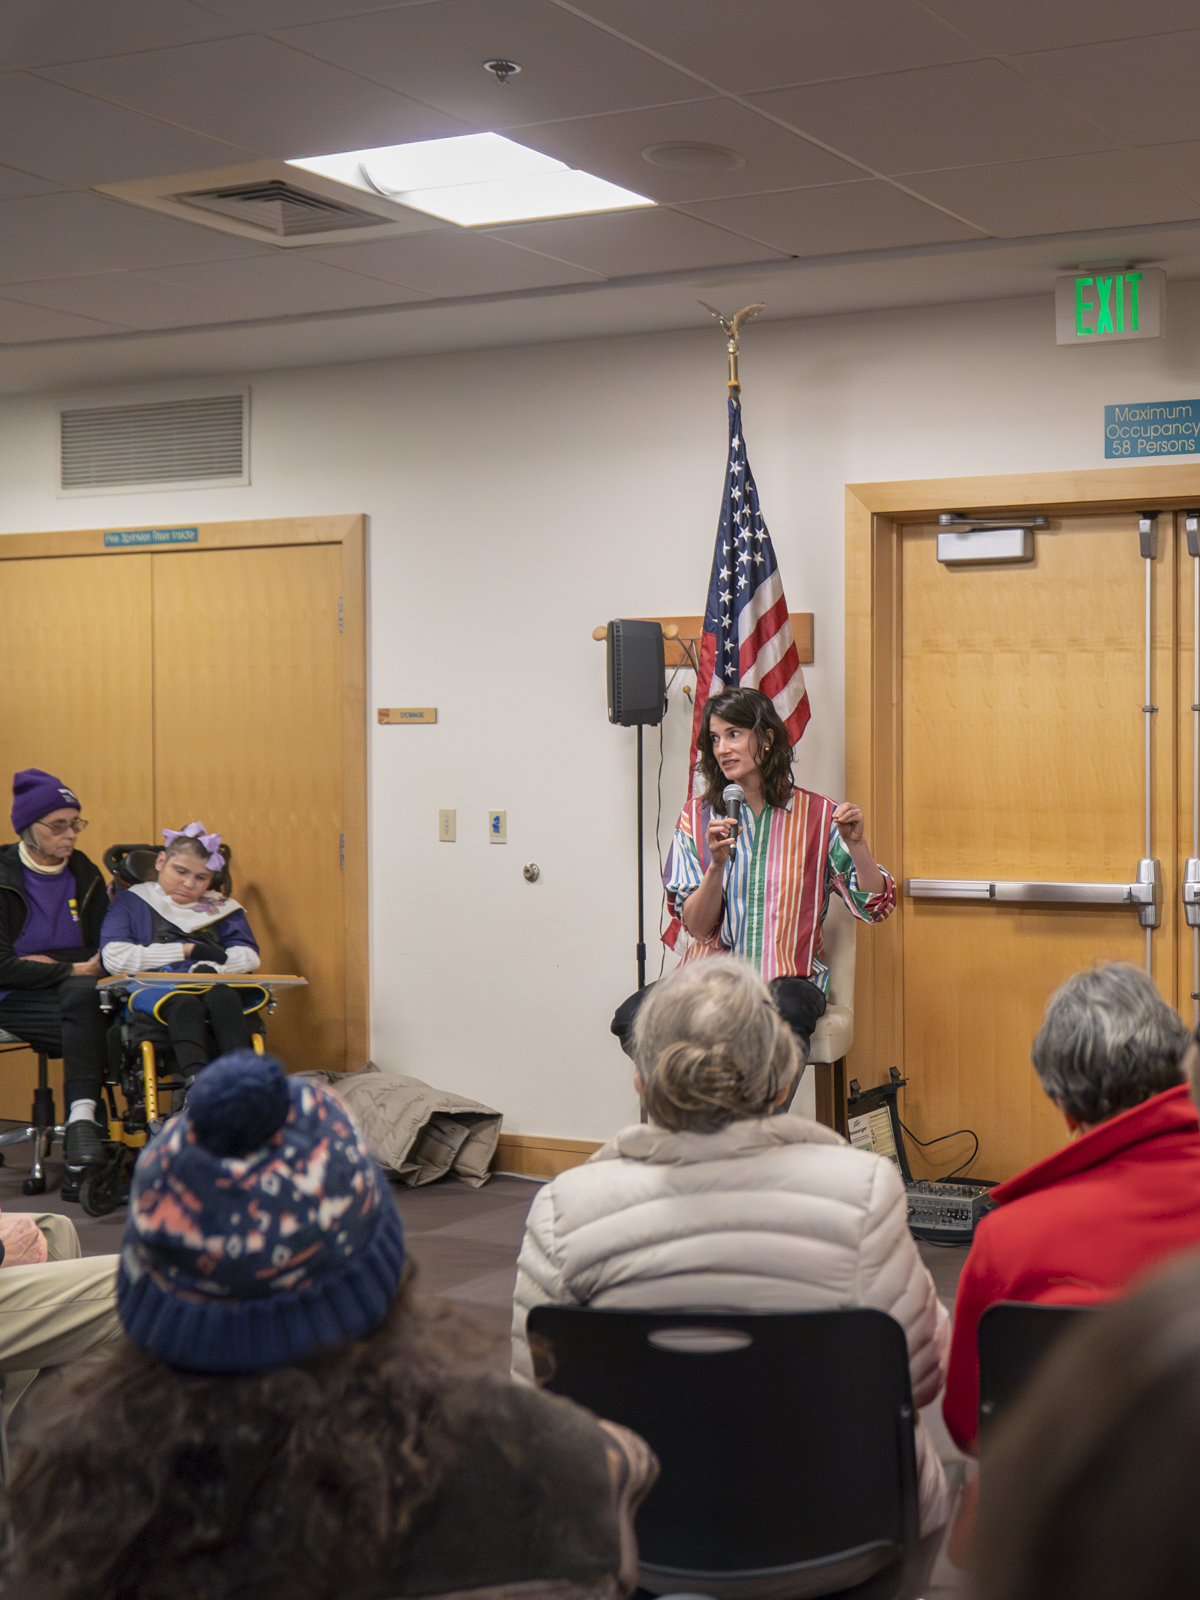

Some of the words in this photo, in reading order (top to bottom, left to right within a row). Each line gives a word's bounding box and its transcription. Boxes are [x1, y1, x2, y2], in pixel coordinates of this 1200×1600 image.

[1075, 272, 1143, 336] EXIT
[1115, 405, 1192, 423] Maximum
[1112, 440, 1132, 456] 58
[1137, 438, 1196, 454] Persons
